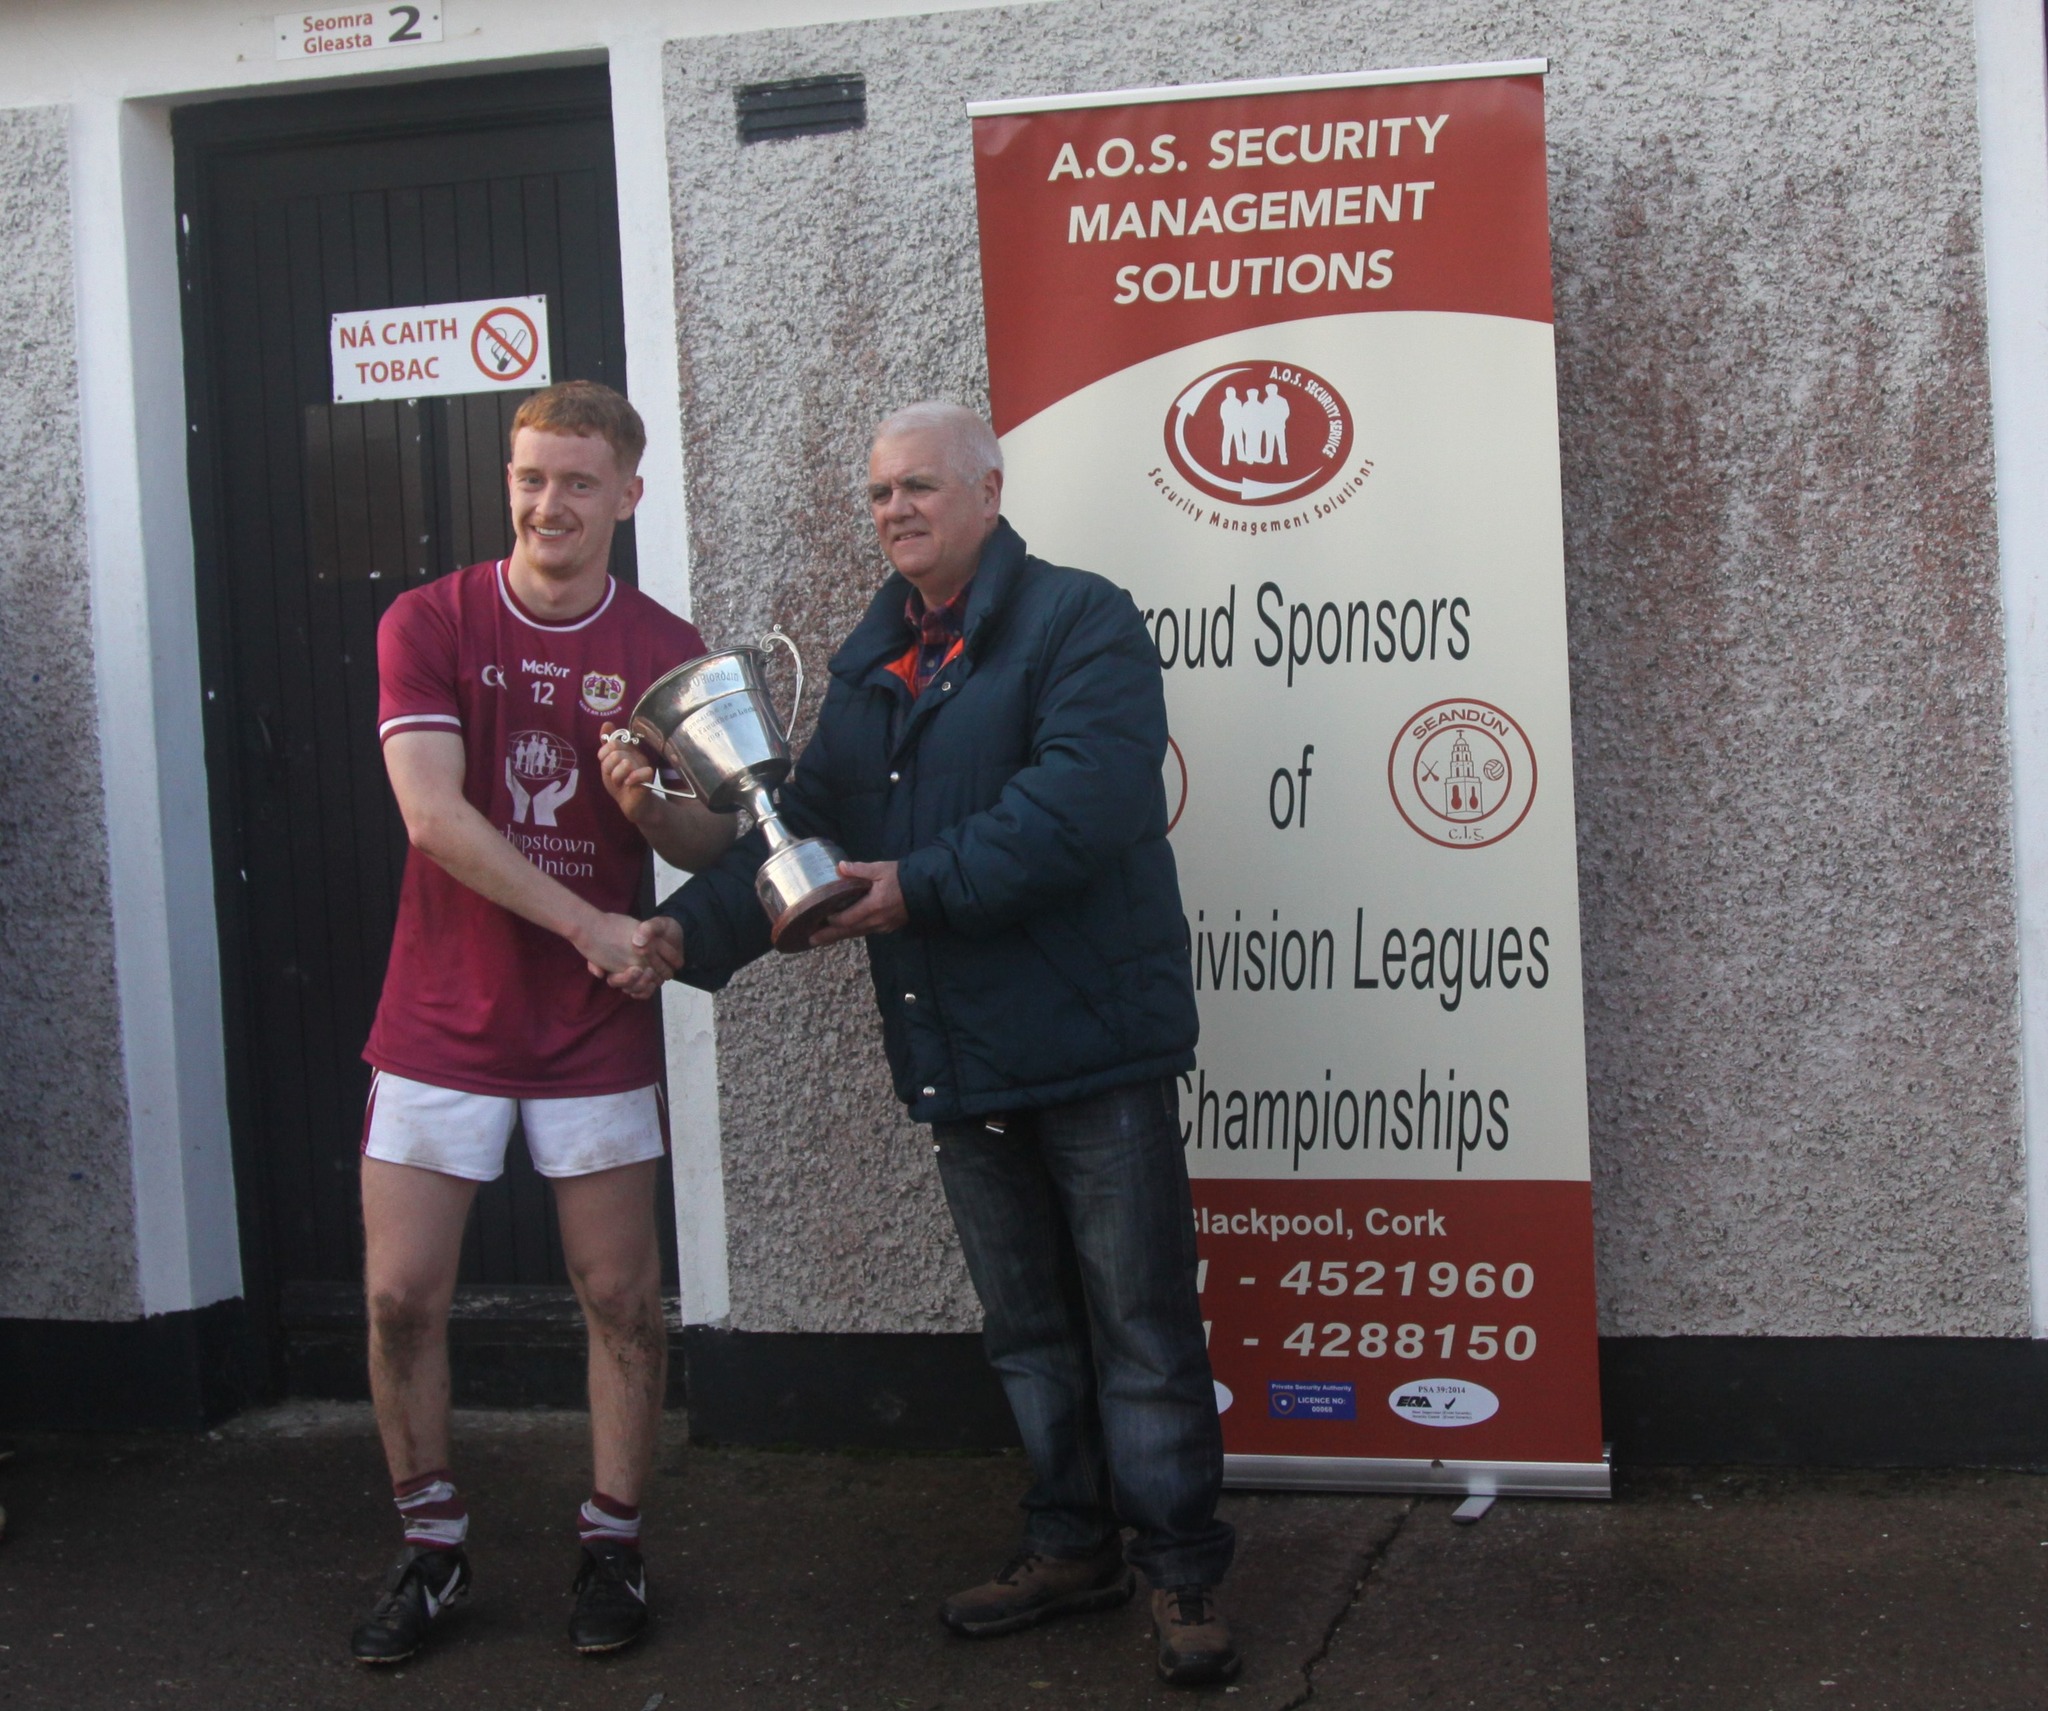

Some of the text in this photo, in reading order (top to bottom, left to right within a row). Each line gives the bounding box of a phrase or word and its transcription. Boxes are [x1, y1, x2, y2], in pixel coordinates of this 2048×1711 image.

[303, 13, 373, 33] Seomra
[388, 5, 422, 43] 2
[303, 34, 373, 54] Gleasta
[1047, 114, 1449, 182] A.O.S. SECURITY
[1067, 181, 1435, 244] MANAGEMENT
[1113, 249, 1395, 305] SOLUTIONS
[340, 318, 458, 349] NÁ CAITH
[355, 356, 440, 384] TOBAC
[1269, 366, 1343, 459] A.O.S. SECURITY SERVICE
[1147, 458, 1375, 536] Security Management Solutions
[1253, 581, 1471, 688] Sponsors
[530, 680, 555, 706] 12
[1269, 744, 1314, 830] of
[1353, 907, 1550, 1012] Leagues
[1365, 1207, 1448, 1237] Cork
[1279, 1260, 1535, 1299] 4521960
[1283, 1322, 1538, 1361] 4288150
[1418, 1386, 1466, 1394] PSA 39:2014
